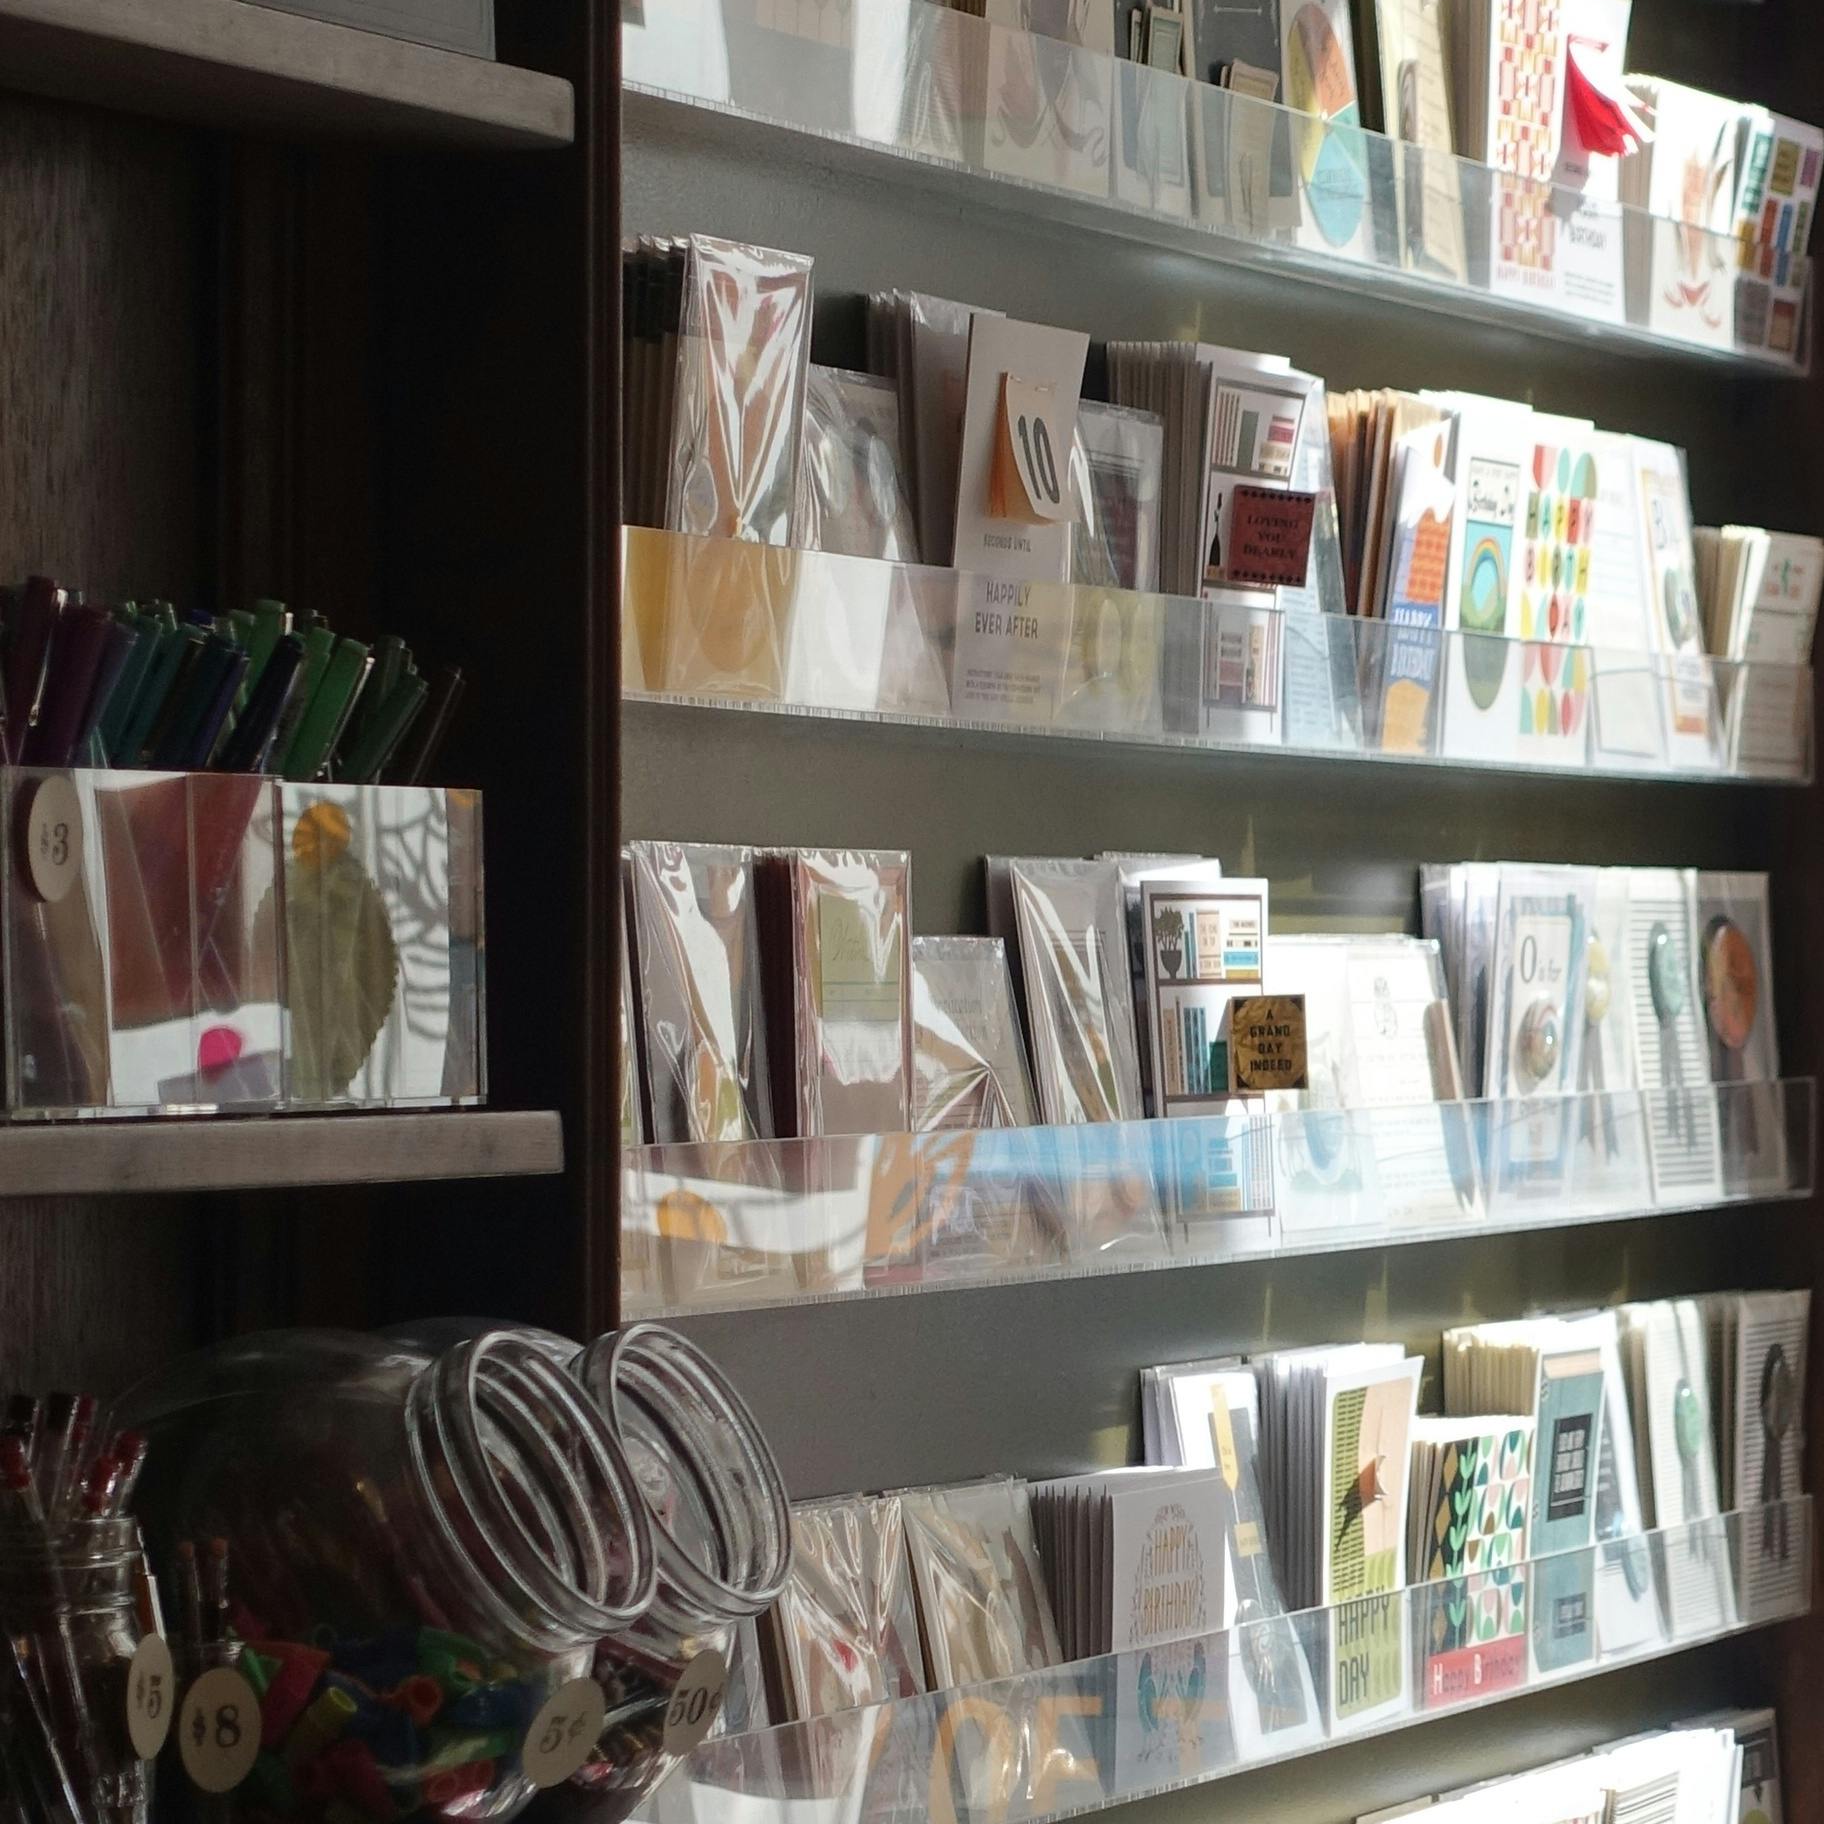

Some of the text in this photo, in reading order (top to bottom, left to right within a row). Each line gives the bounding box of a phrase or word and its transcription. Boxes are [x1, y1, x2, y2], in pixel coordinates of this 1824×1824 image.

[1016, 414, 1061, 505] 10
[1246, 512, 1299, 531] LOVING
[1257, 528, 1288, 544] YOU
[983, 533, 1031, 553] SECONDS UNTIL
[1243, 541, 1297, 561] DEARLY
[986, 579, 1032, 608] HAPPILY
[975, 611, 1039, 640] EVER AFTER
[1265, 1008, 1274, 1020] A
[1249, 1025, 1290, 1038] GRAND
[1258, 1042, 1283, 1054] DAY
[1249, 1058, 1293, 1073] INDEED
[1337, 1595, 1391, 1647] HAPPY
[1337, 1651, 1370, 1706] DAY
[136, 1673, 160, 1720] $5
[667, 1680, 725, 1729] 50¢
[191, 1703, 242, 1750] $8
[538, 1708, 588, 1753] 5¢
